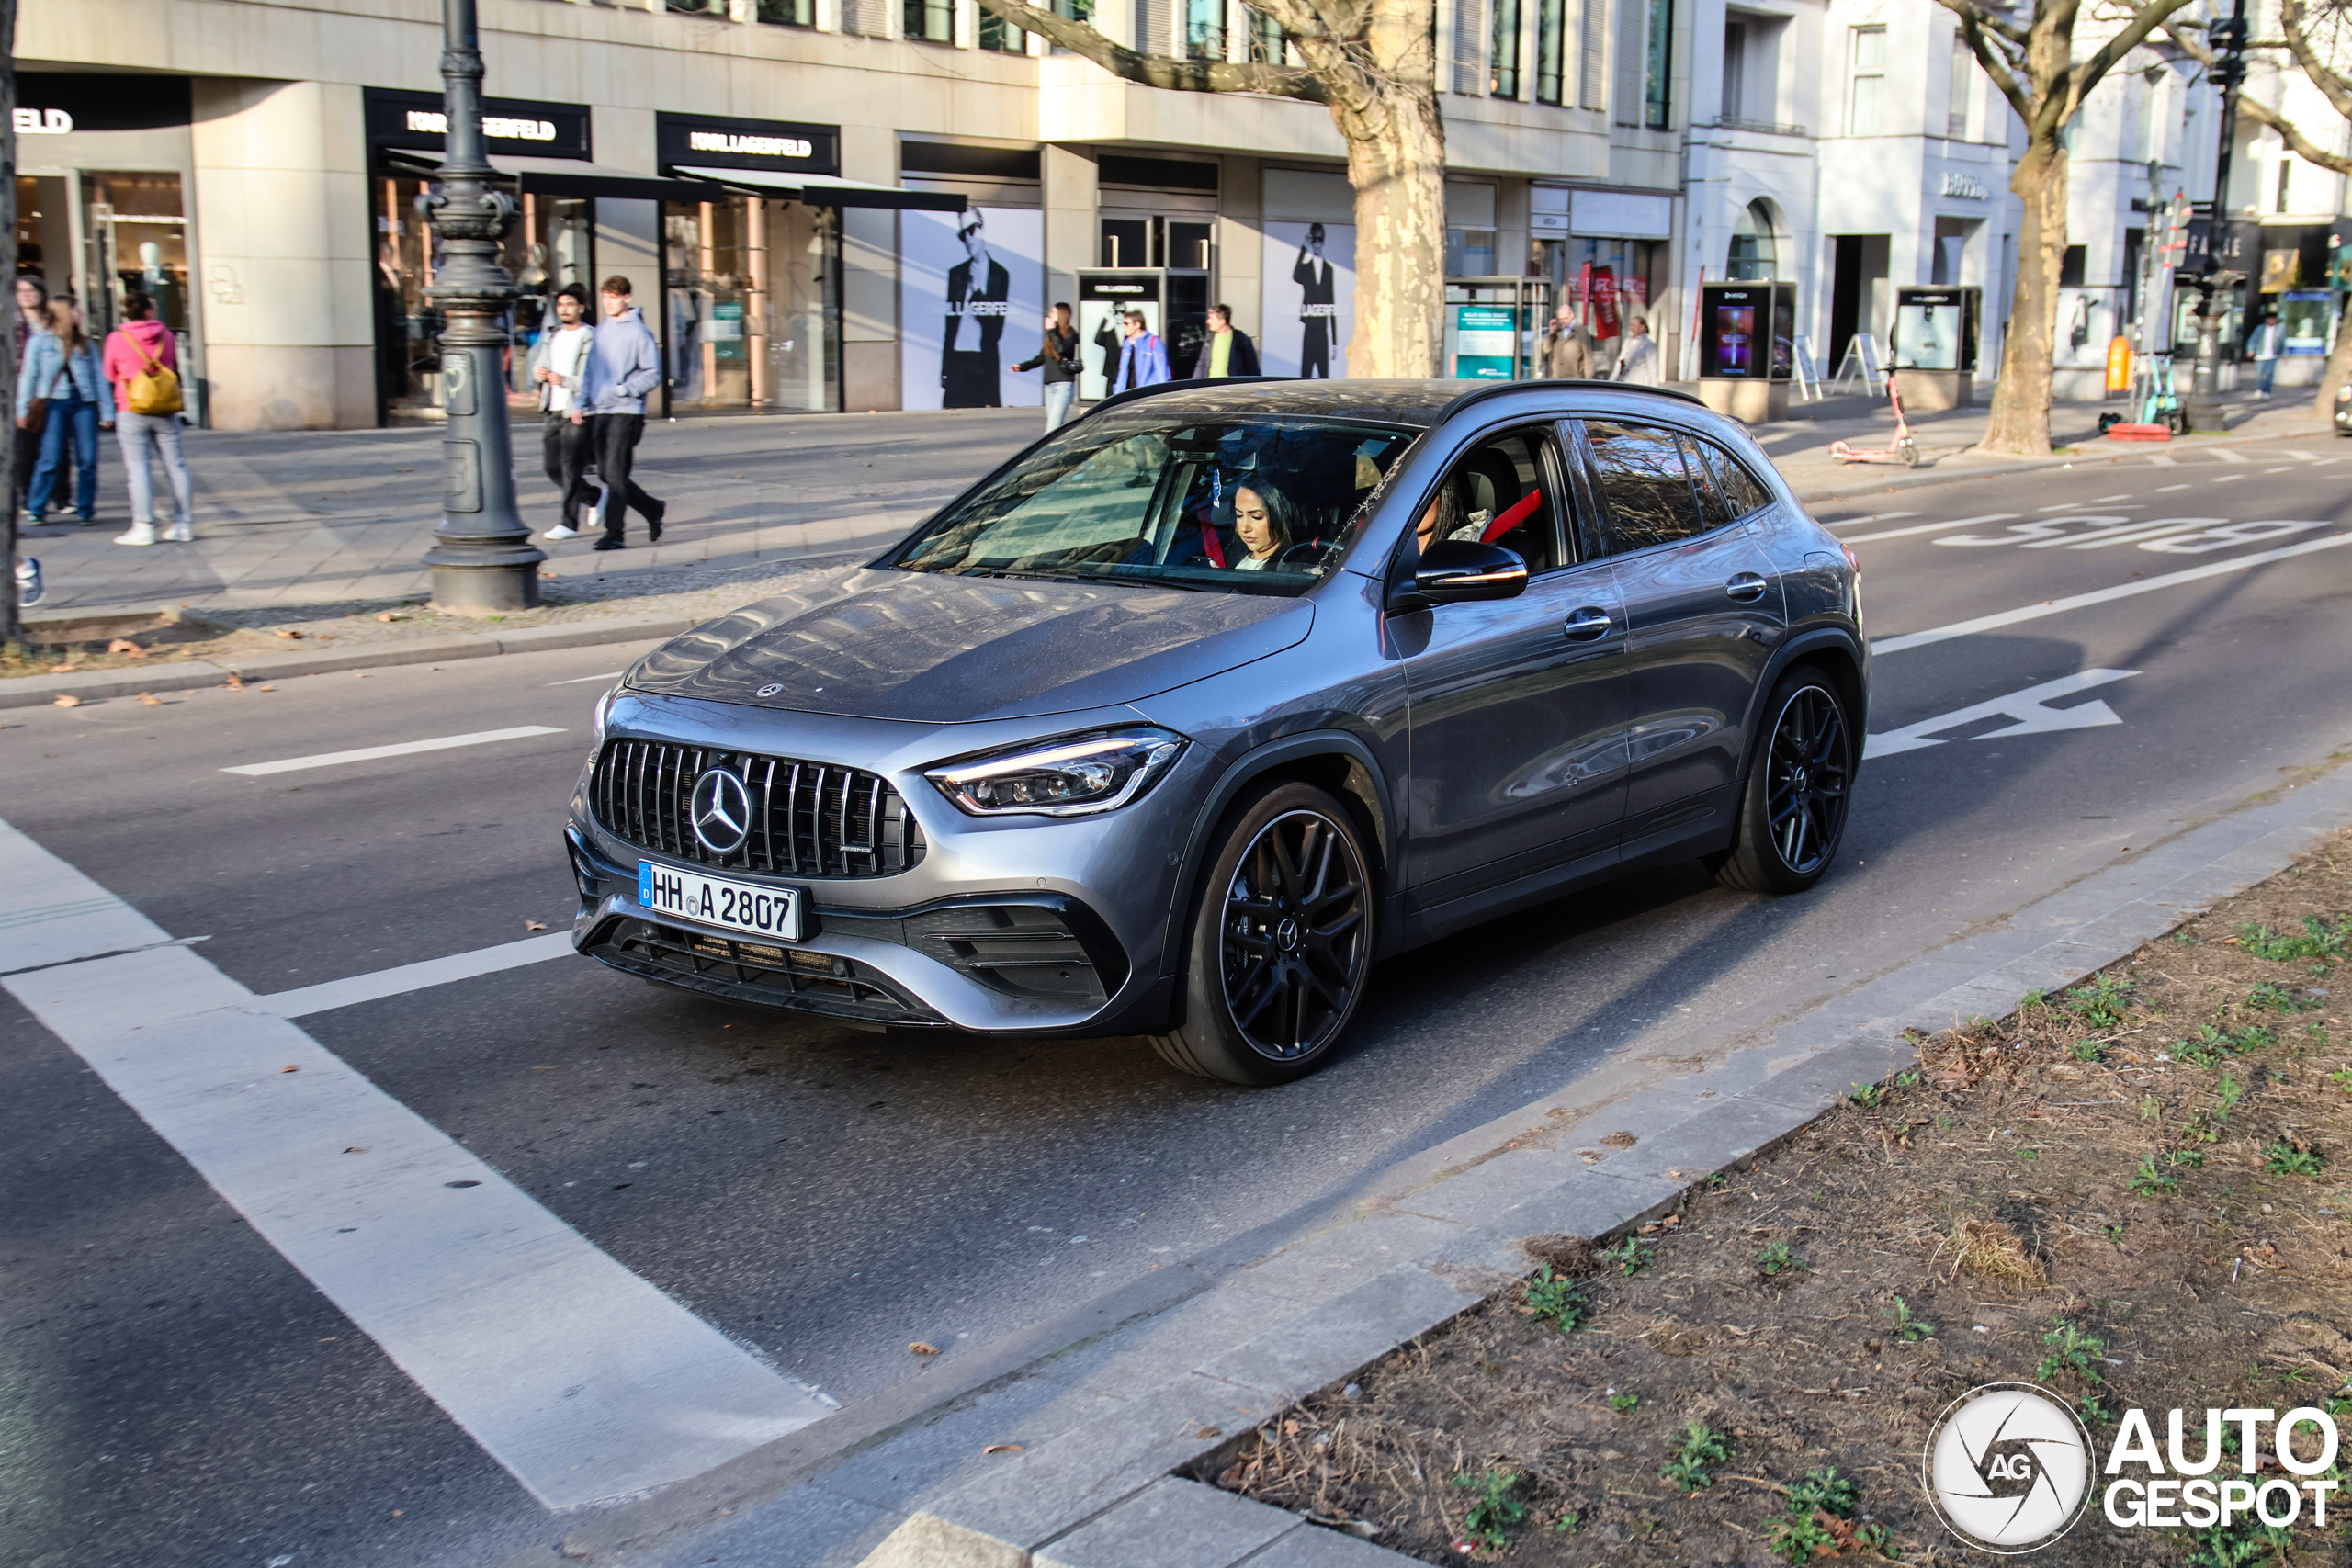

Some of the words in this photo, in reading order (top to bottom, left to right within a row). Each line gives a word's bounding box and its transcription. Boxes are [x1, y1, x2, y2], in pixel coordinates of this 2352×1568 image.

[406, 110, 449, 133] KAR
[730, 134, 812, 157] LAGERFELD
[643, 888, 650, 899] D
[653, 871, 683, 911] HH
[700, 883, 716, 919] A
[721, 887, 790, 932] 2807
